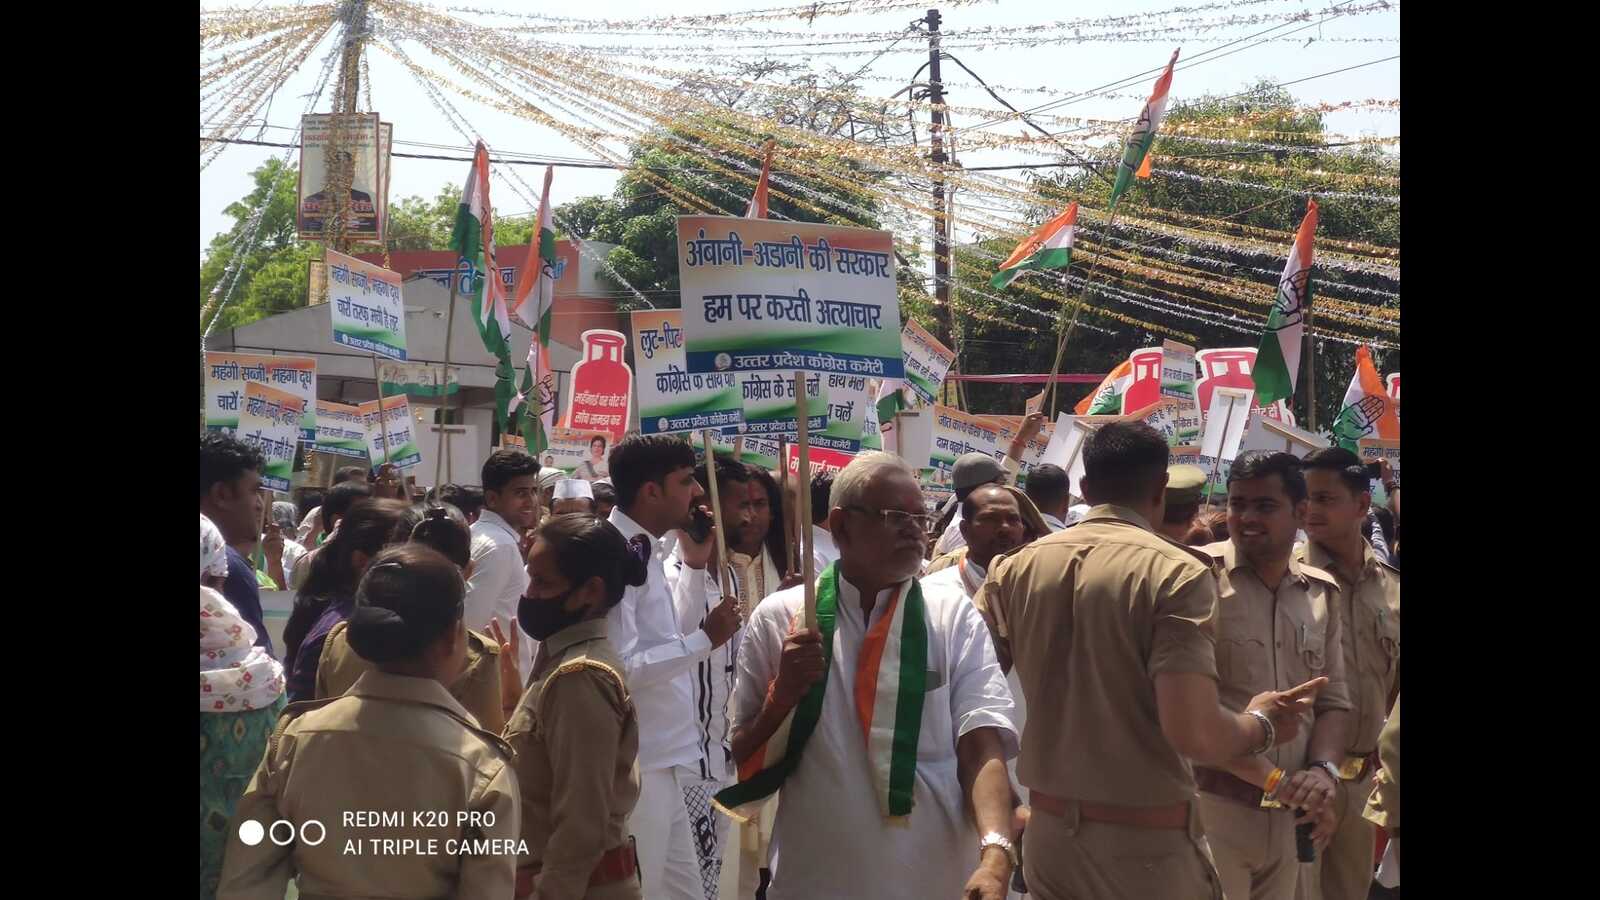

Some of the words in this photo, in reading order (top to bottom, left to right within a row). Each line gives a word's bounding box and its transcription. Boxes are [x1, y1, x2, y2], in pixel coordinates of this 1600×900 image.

[686, 229, 804, 269] अंबानी-अडानी
[808, 238, 832, 272] की
[834, 247, 890, 278] सरकार
[703, 294, 732, 323] हम
[737, 295, 762, 320] पर
[765, 288, 811, 323] करती
[815, 299, 882, 330] अत्याचार
[734, 355, 770, 369] उत्तर
[773, 352, 806, 369] प्रदेश
[808, 353, 847, 370] कांग्रेस
[850, 359, 884, 374] कमेटी
[212, 361, 239, 381] महंगी
[300, 370, 312, 391] दूध
[773, 374, 784, 398] के
[217, 390, 239, 411] चारों
[835, 400, 854, 422] चलें
